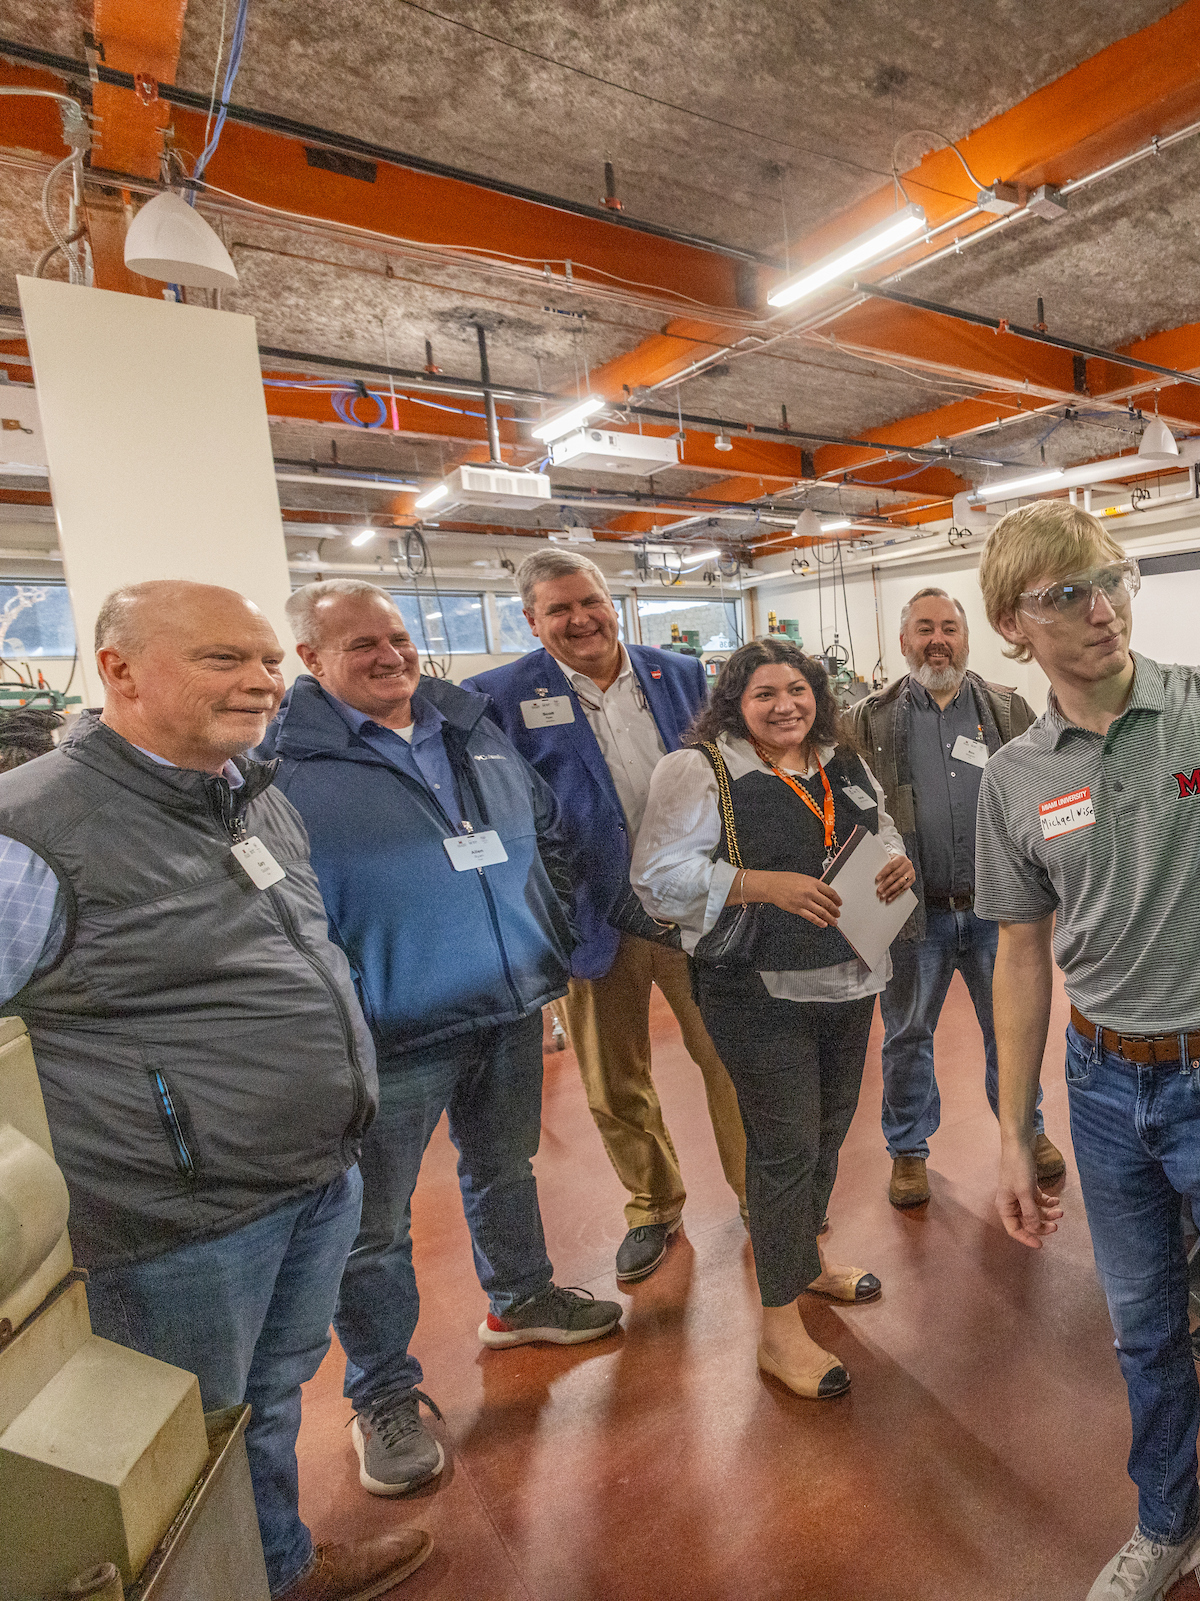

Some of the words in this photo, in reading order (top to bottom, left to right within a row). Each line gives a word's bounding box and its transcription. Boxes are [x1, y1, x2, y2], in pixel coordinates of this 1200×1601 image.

[1041, 801, 1058, 812] MIAMI
[1059, 790, 1087, 807] UNIVERSITY
[1041, 809, 1075, 831] Michael
